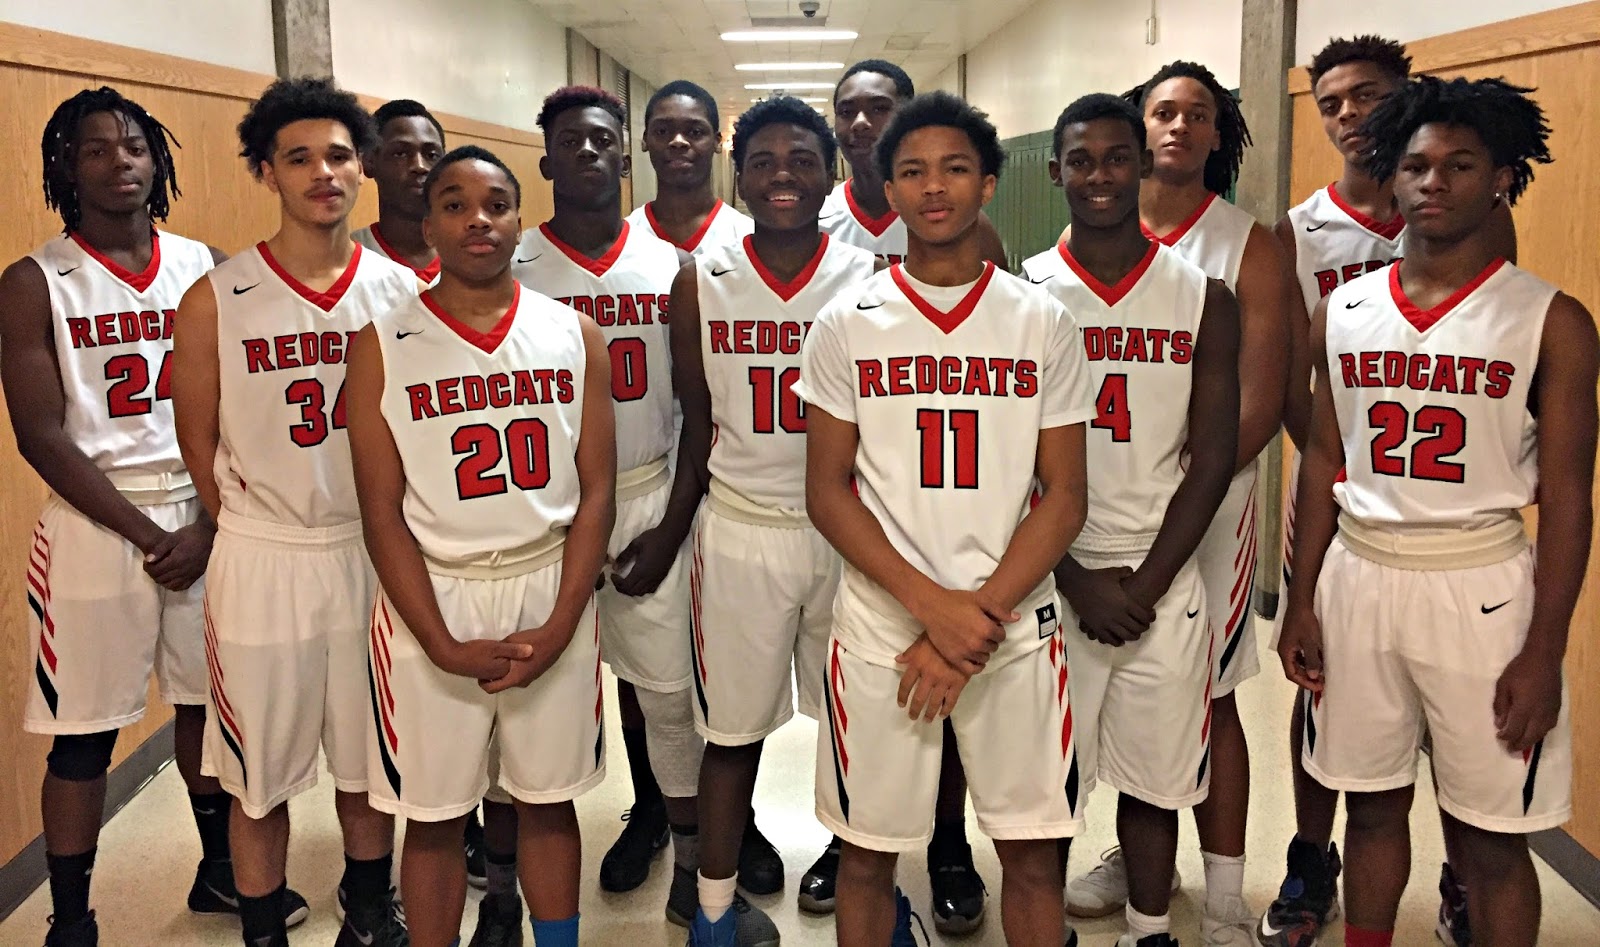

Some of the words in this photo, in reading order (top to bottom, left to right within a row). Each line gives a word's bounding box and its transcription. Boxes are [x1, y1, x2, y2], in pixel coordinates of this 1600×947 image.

[553, 293, 670, 326] DCATS
[707, 320, 814, 354] REDC
[1080, 326, 1193, 364] DCATS
[405, 368, 575, 421] REDCATS
[748, 366, 808, 434] 10
[854, 355, 1039, 399] REDCATS
[1338, 350, 1515, 399] REDCATS
[1091, 373, 1131, 442] 4
[451, 417, 551, 501] 20
[916, 408, 979, 489] 11
[1367, 400, 1466, 483] 22
[1042, 608, 1051, 620] M
